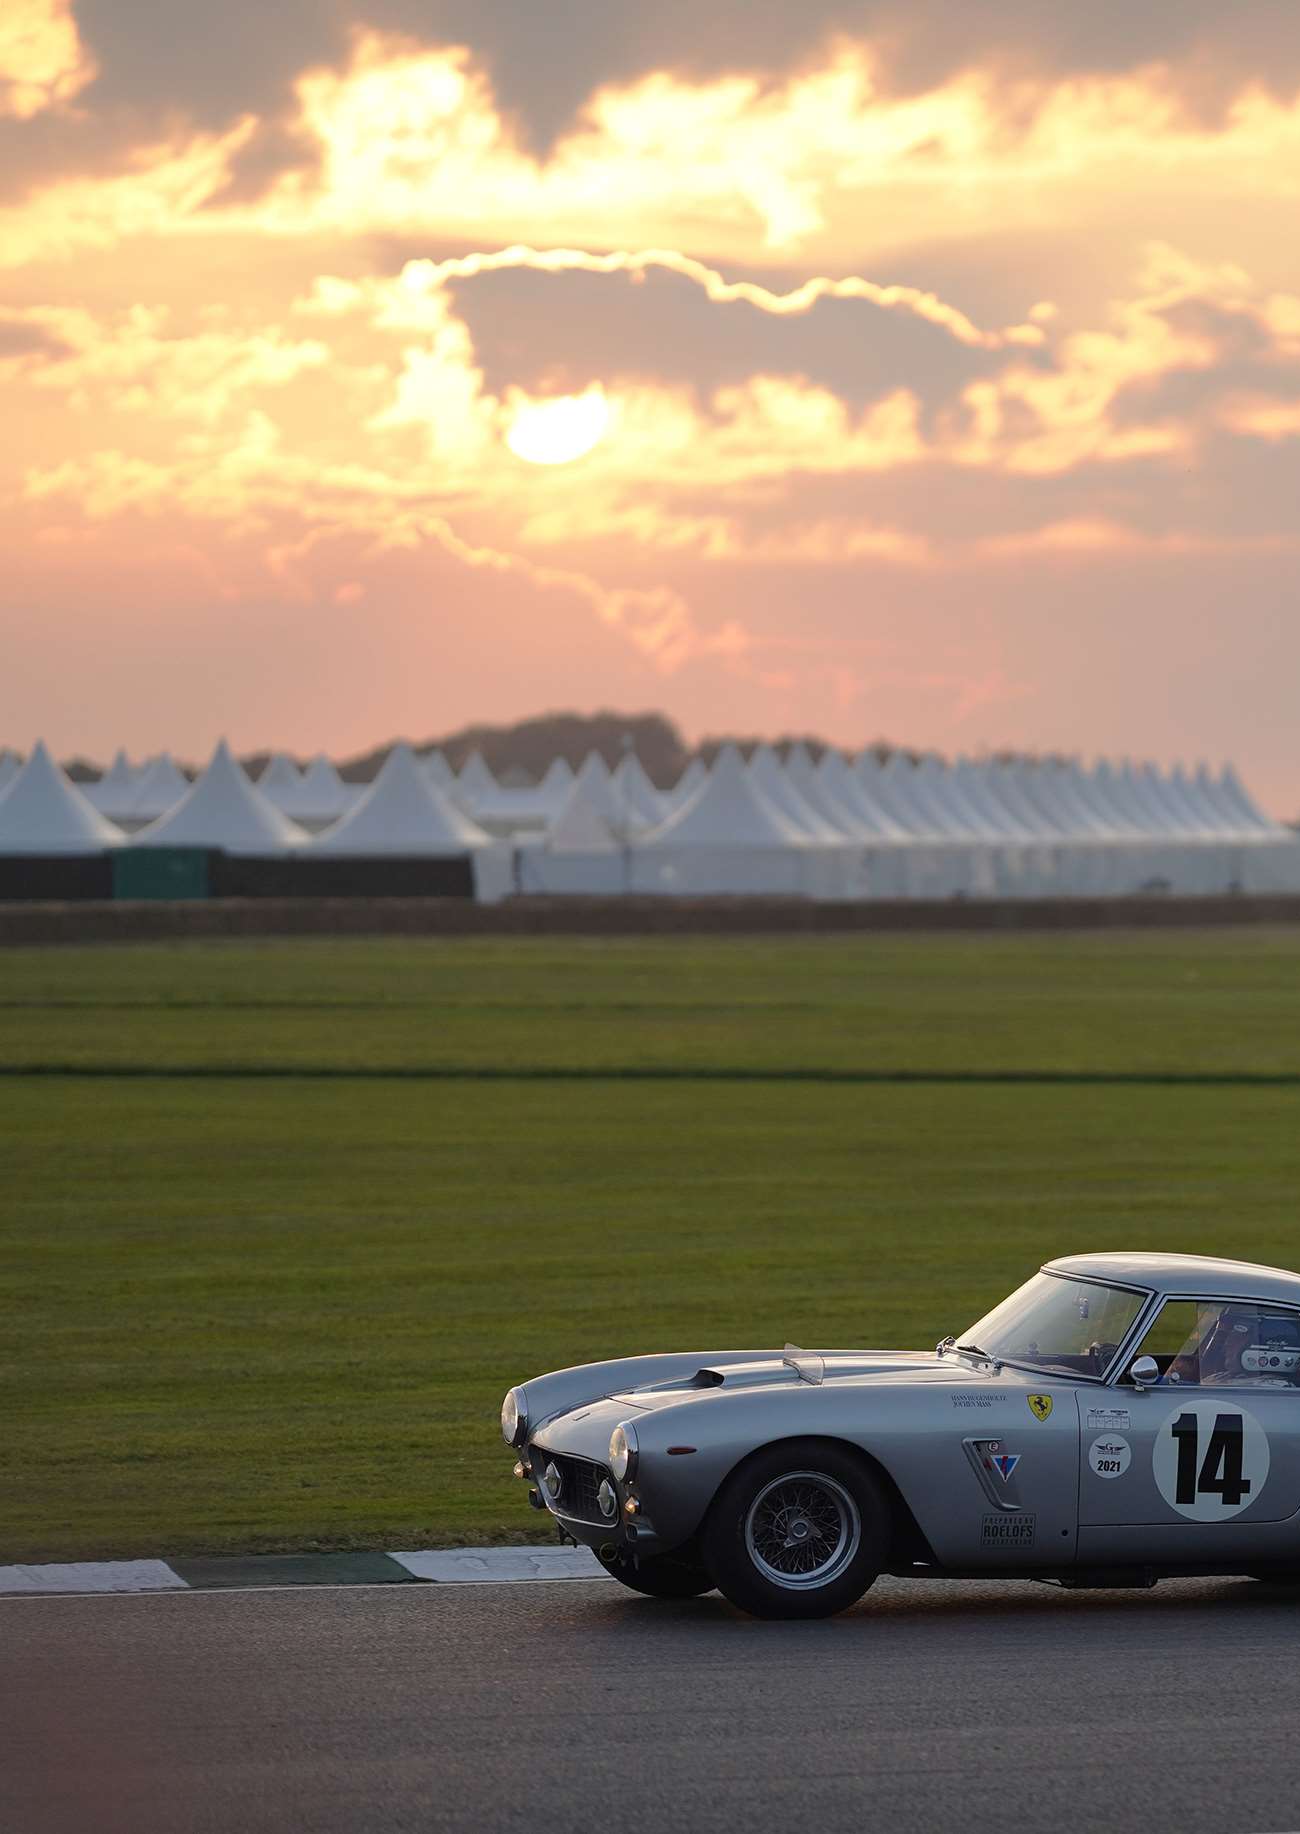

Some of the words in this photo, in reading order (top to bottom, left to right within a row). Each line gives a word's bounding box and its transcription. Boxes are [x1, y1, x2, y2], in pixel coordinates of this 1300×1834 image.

[1171, 1413, 1250, 1505] 14
[1097, 1460, 1121, 1472] 2021
[984, 1525, 1033, 1537] ROELOFS
